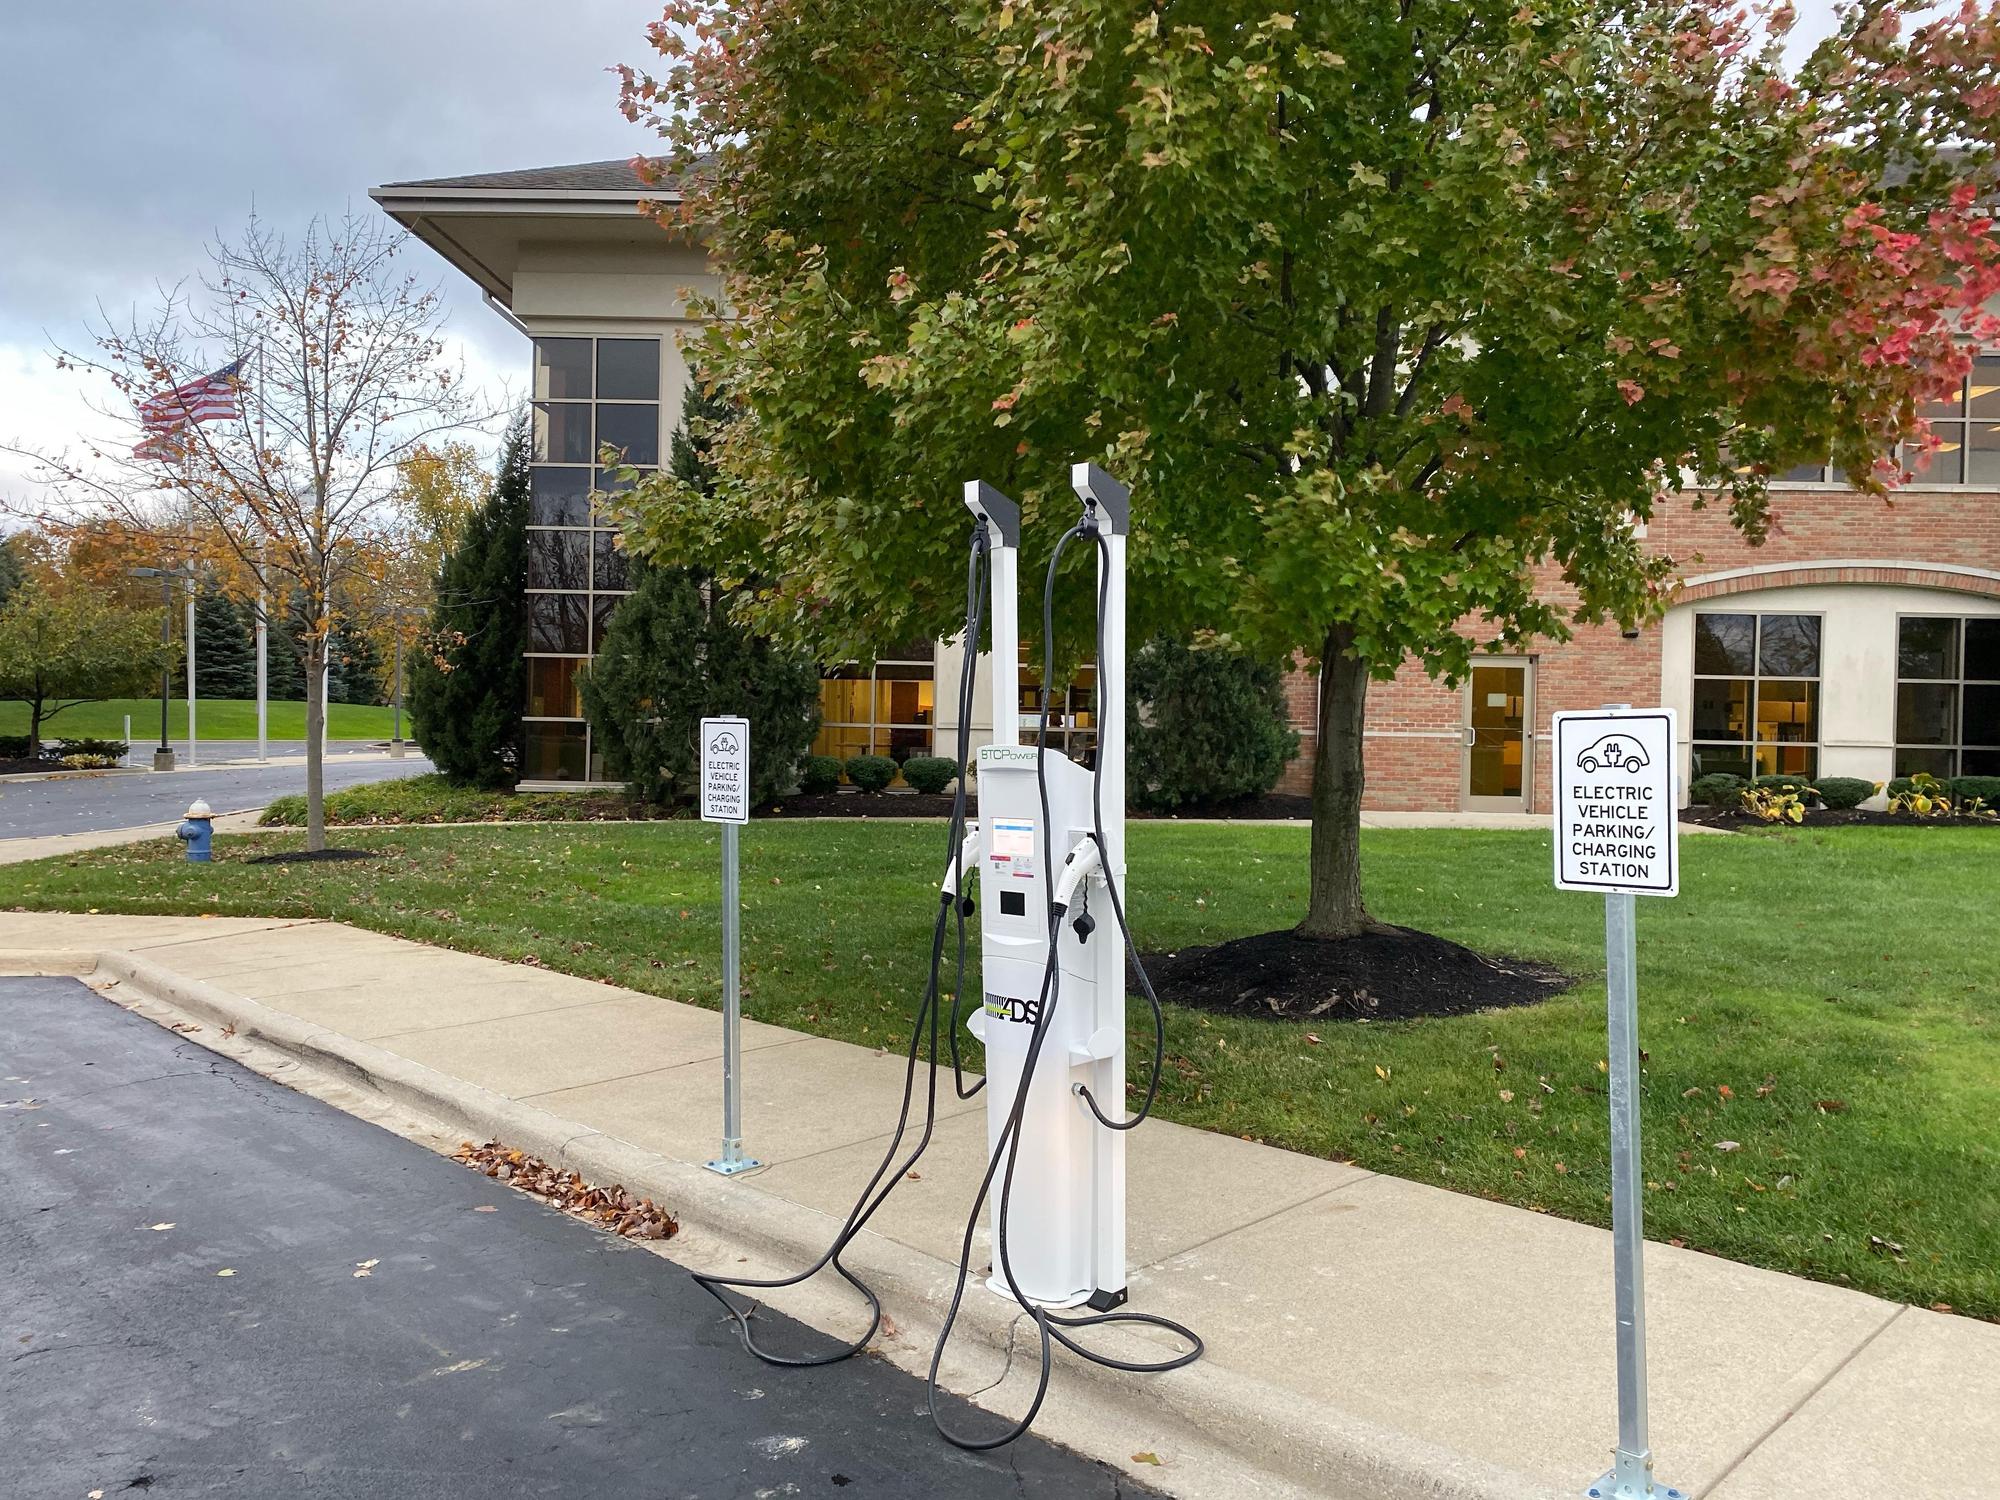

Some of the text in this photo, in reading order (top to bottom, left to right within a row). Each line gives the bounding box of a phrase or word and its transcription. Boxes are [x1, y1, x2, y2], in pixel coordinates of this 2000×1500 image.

[708, 761, 740, 771] ELECTRIC
[710, 772, 738, 782] VEHICLE
[708, 782, 741, 793] PARKING/
[1573, 786, 1653, 801] ELECTRIC
[708, 793, 740, 804] CHARGING
[710, 804, 738, 814] STATION
[1578, 805, 1649, 820] VEHICLE
[1573, 824, 1656, 840] PARKING/
[1572, 842, 1656, 859] CHARGING
[1579, 861, 1649, 879] STATION
[998, 997, 1040, 1025] ADS
